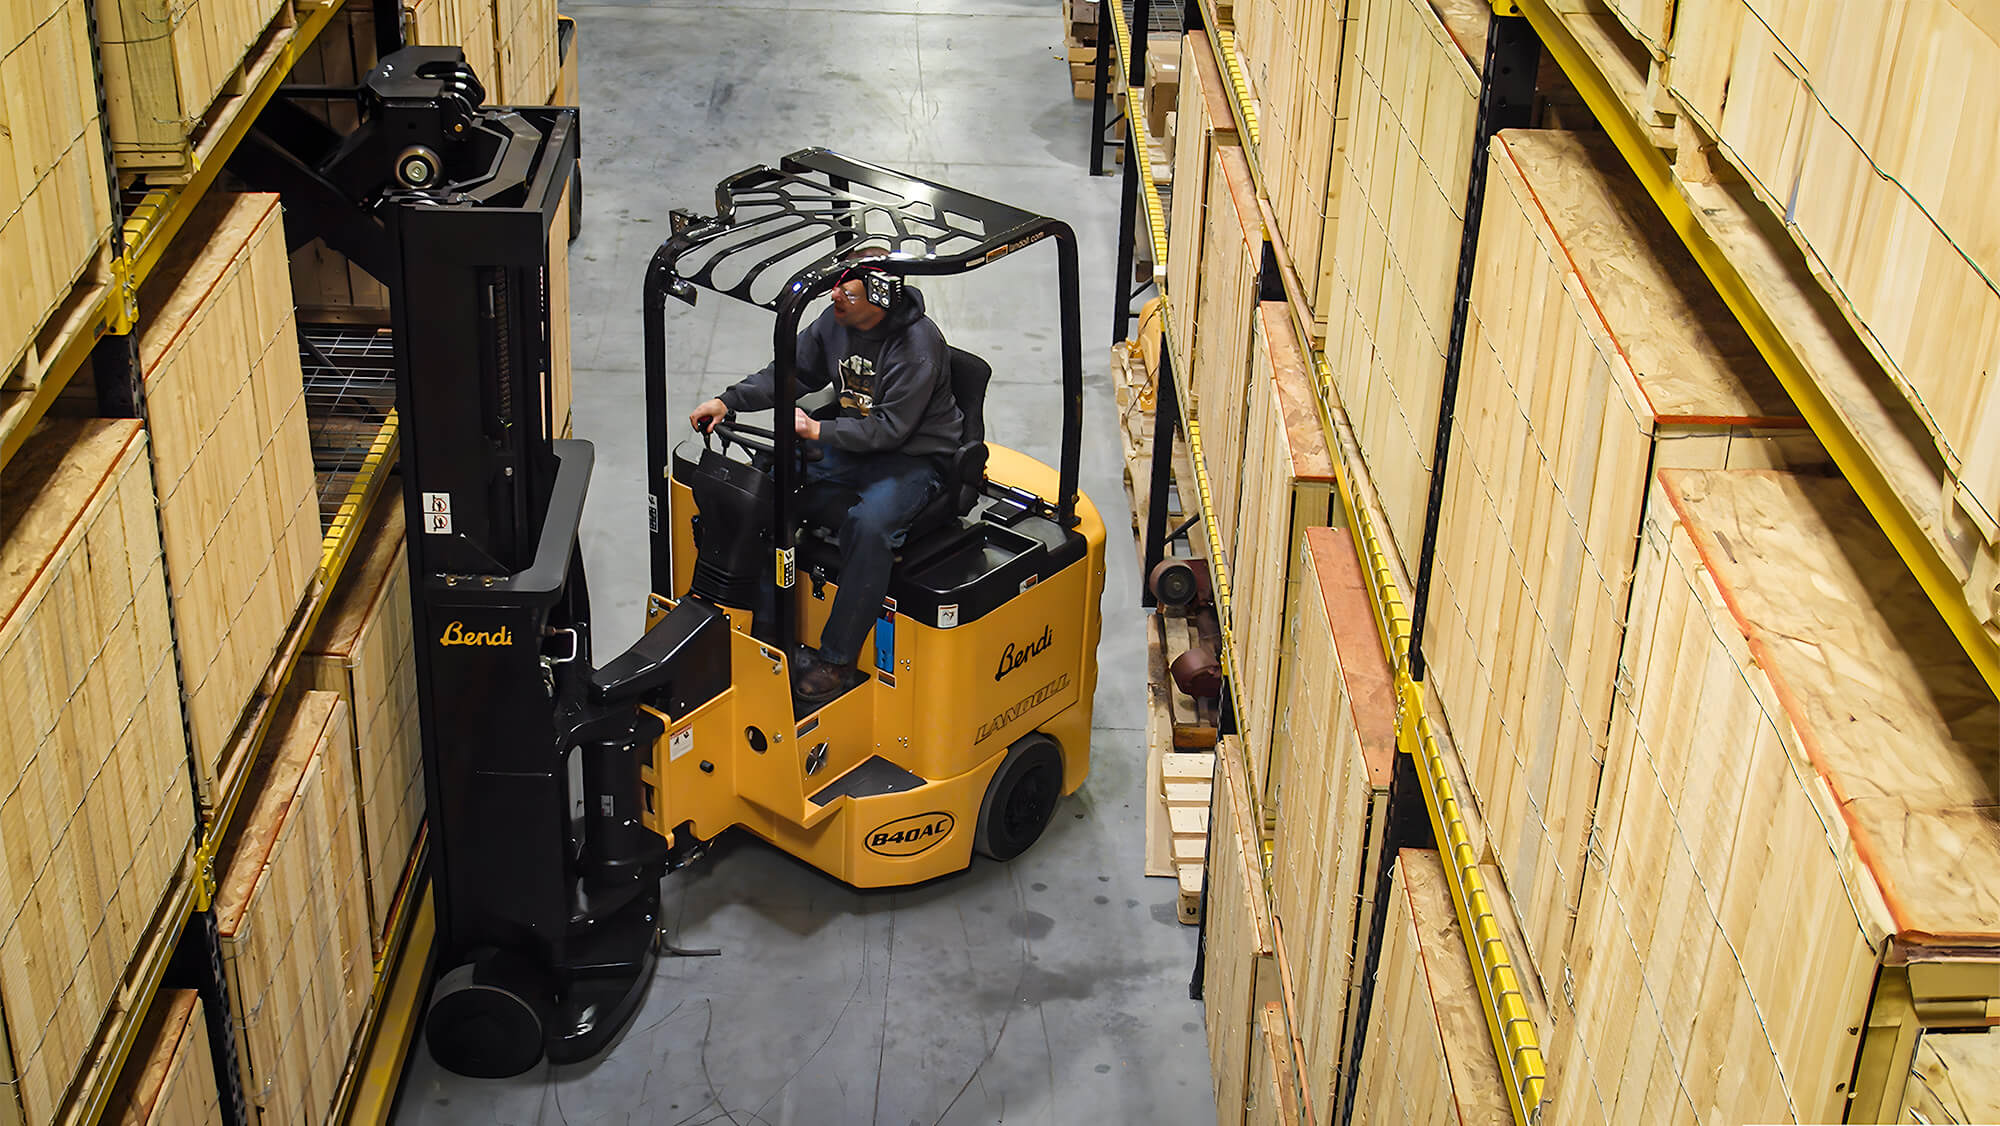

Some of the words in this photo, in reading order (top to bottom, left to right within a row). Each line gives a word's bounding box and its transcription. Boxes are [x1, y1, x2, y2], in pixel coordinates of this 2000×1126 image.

[440, 620, 512, 646] Bendi
[995, 624, 1053, 681] Bendi
[974, 673, 1071, 745] LANDOLL
[871, 818, 948, 847] B40AC
